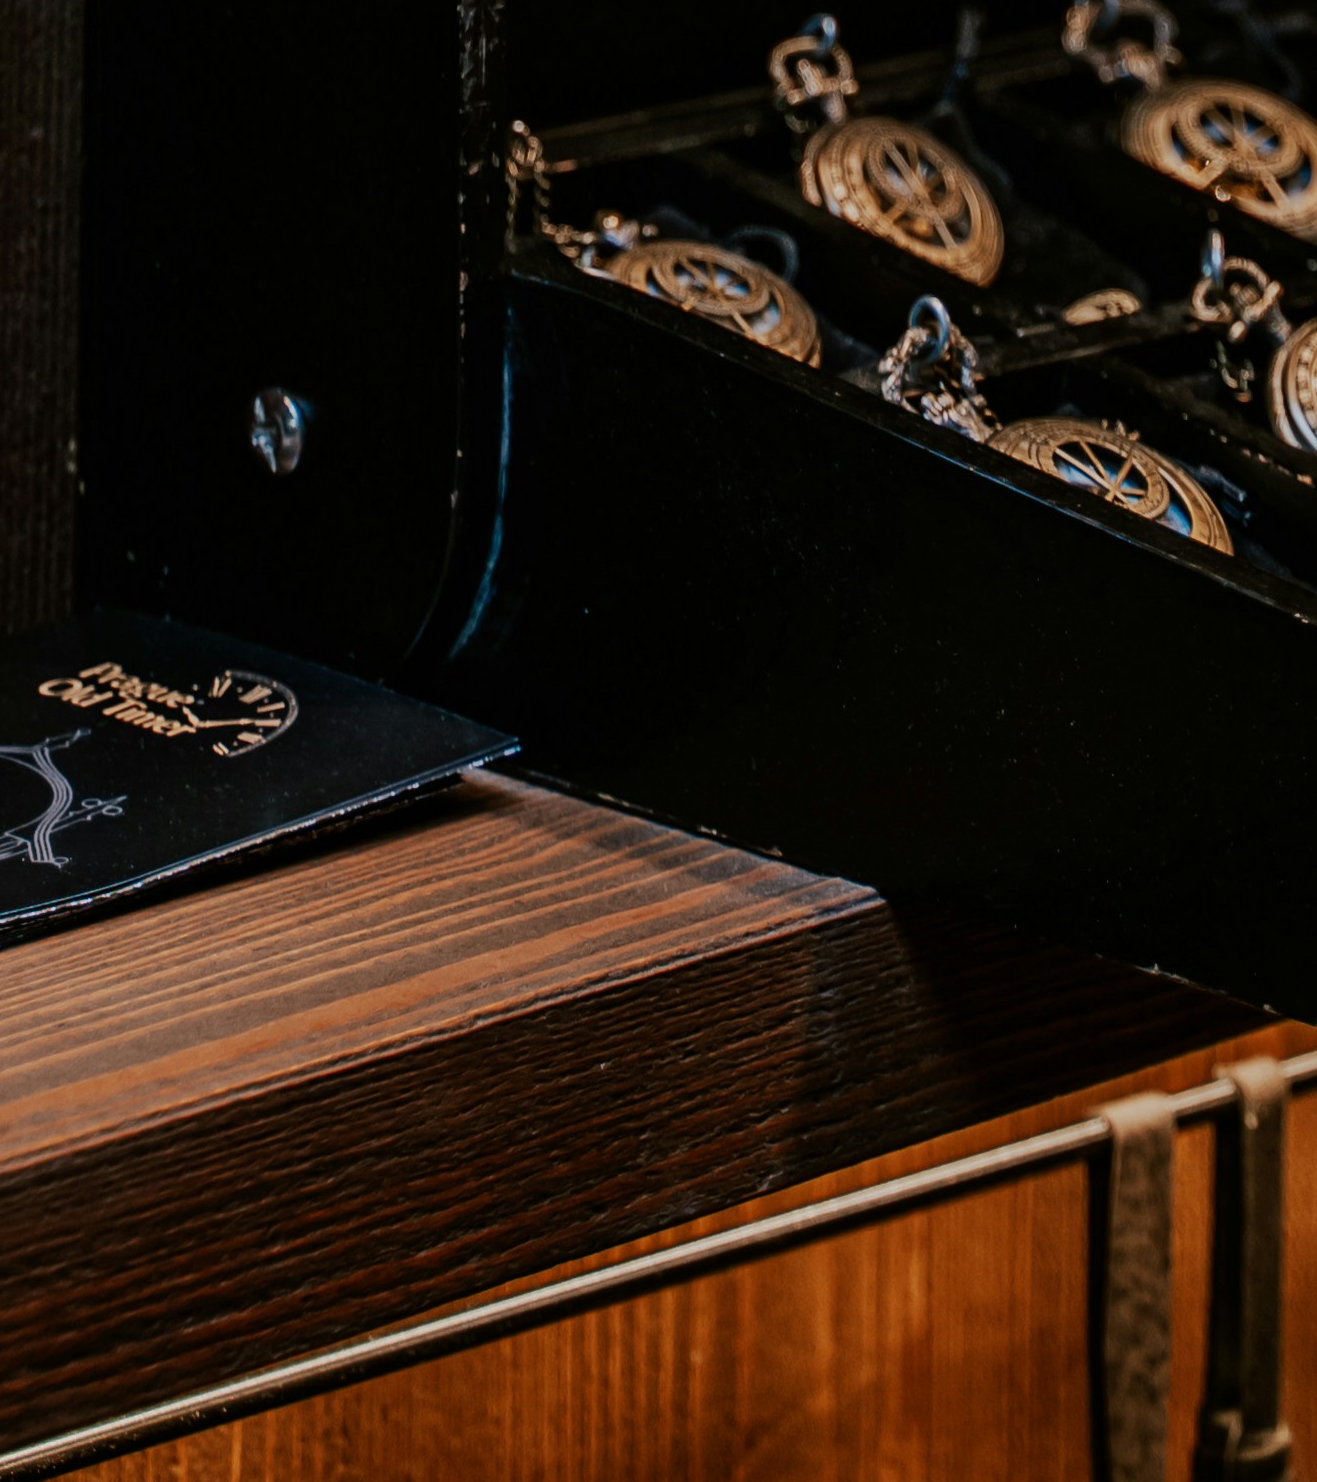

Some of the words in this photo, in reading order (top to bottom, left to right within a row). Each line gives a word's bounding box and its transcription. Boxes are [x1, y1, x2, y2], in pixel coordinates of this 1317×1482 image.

[38, 677, 114, 708] Old
[103, 694, 197, 738] Timer
[79, 661, 195, 709] Prague
